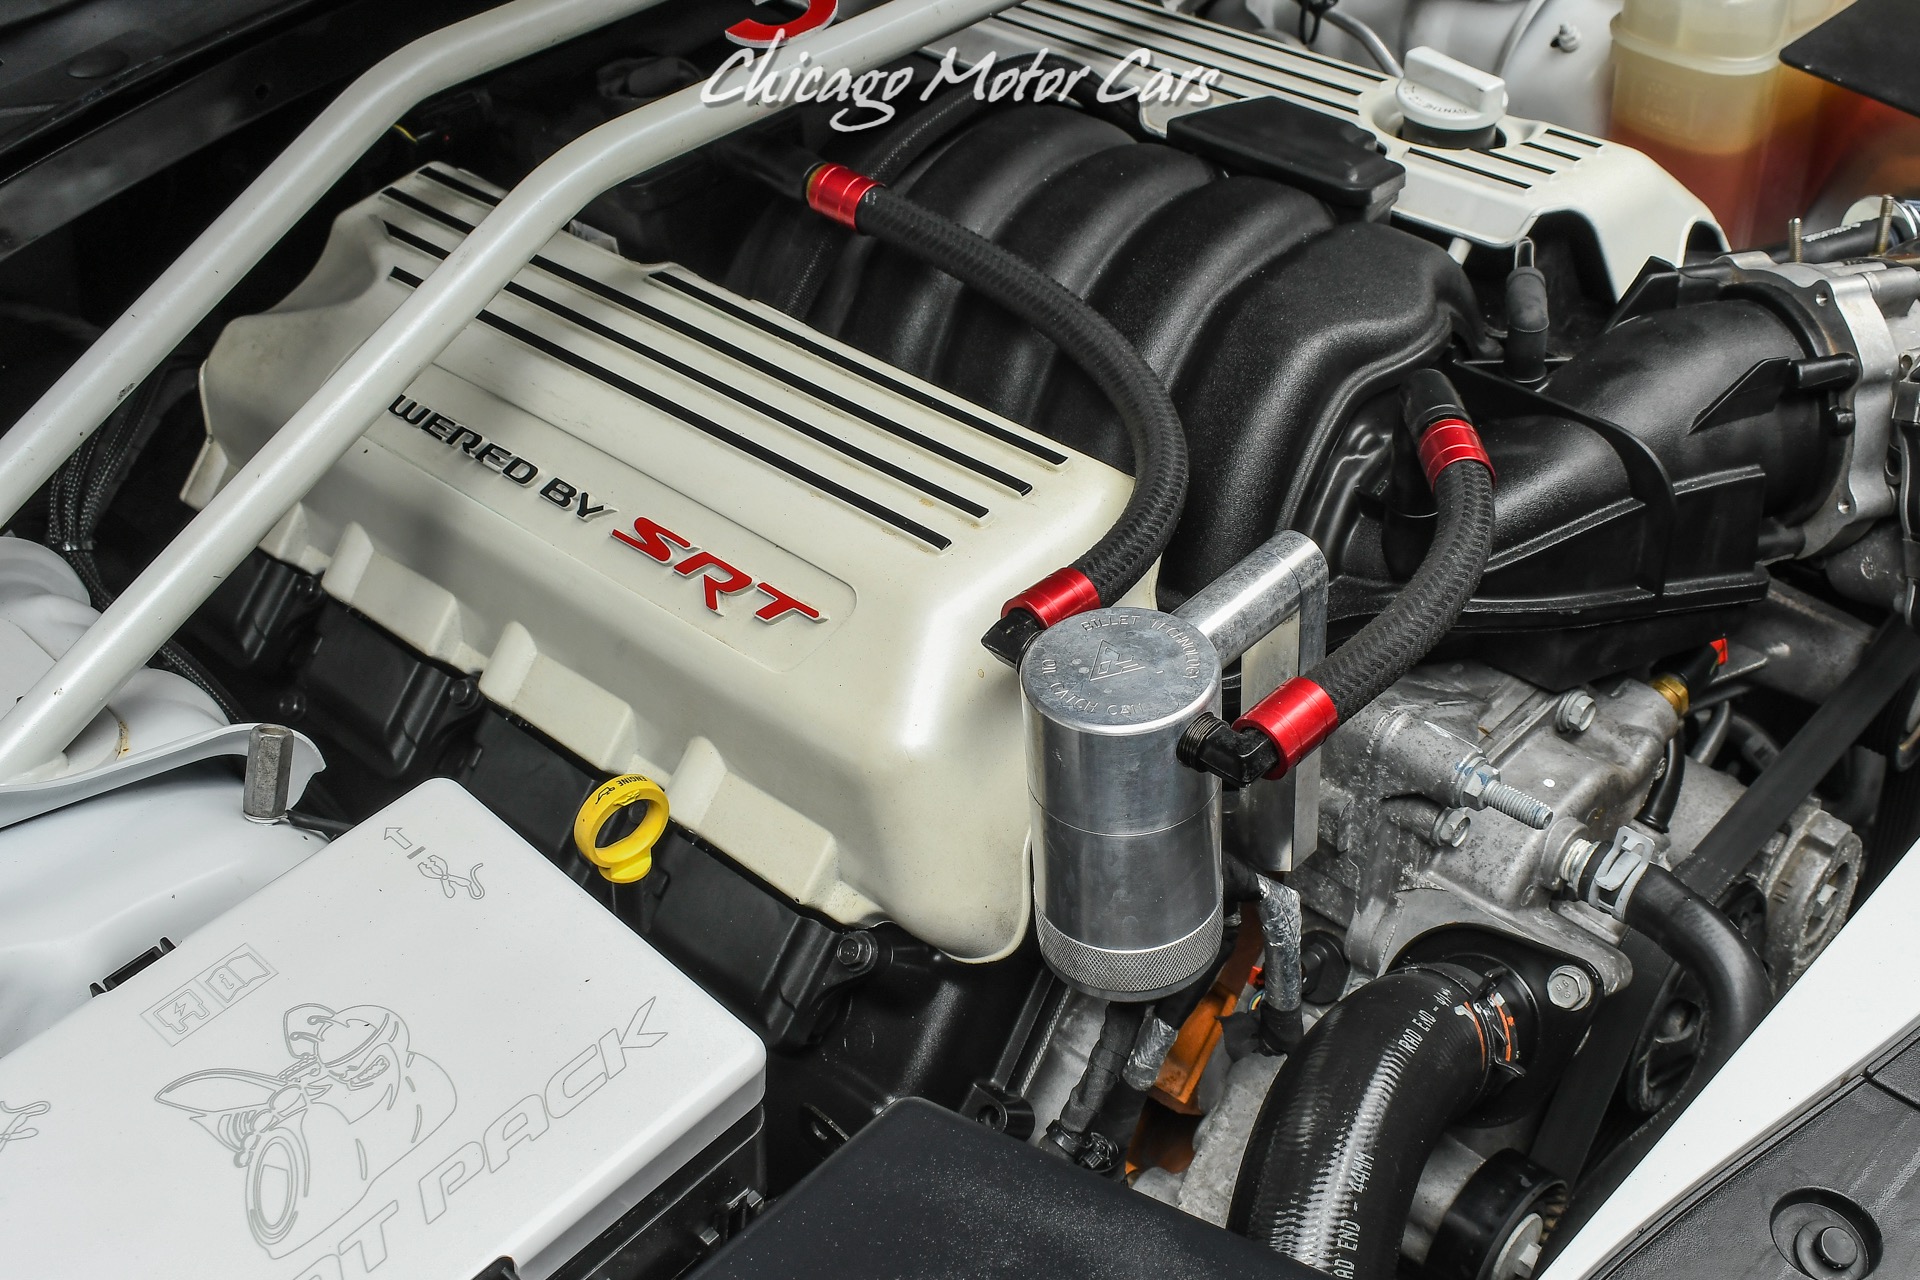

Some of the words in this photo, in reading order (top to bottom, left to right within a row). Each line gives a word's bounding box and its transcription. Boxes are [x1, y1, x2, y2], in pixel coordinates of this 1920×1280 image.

[539, 476, 614, 522] BY
[610, 516, 829, 623] SRT
[1081, 614, 1141, 632] BILLET
[1150, 618, 1202, 680] TECHNOLOGY
[1050, 681, 1099, 713] CATCH
[615, 775, 648, 787] ENGINE
[1398, 1028, 1424, 1054] RAD
[1411, 1009, 1437, 1033] END
[418, 996, 669, 1225] PACK
[1348, 1150, 1375, 1193] 44MM
[1337, 1219, 1361, 1252] END
